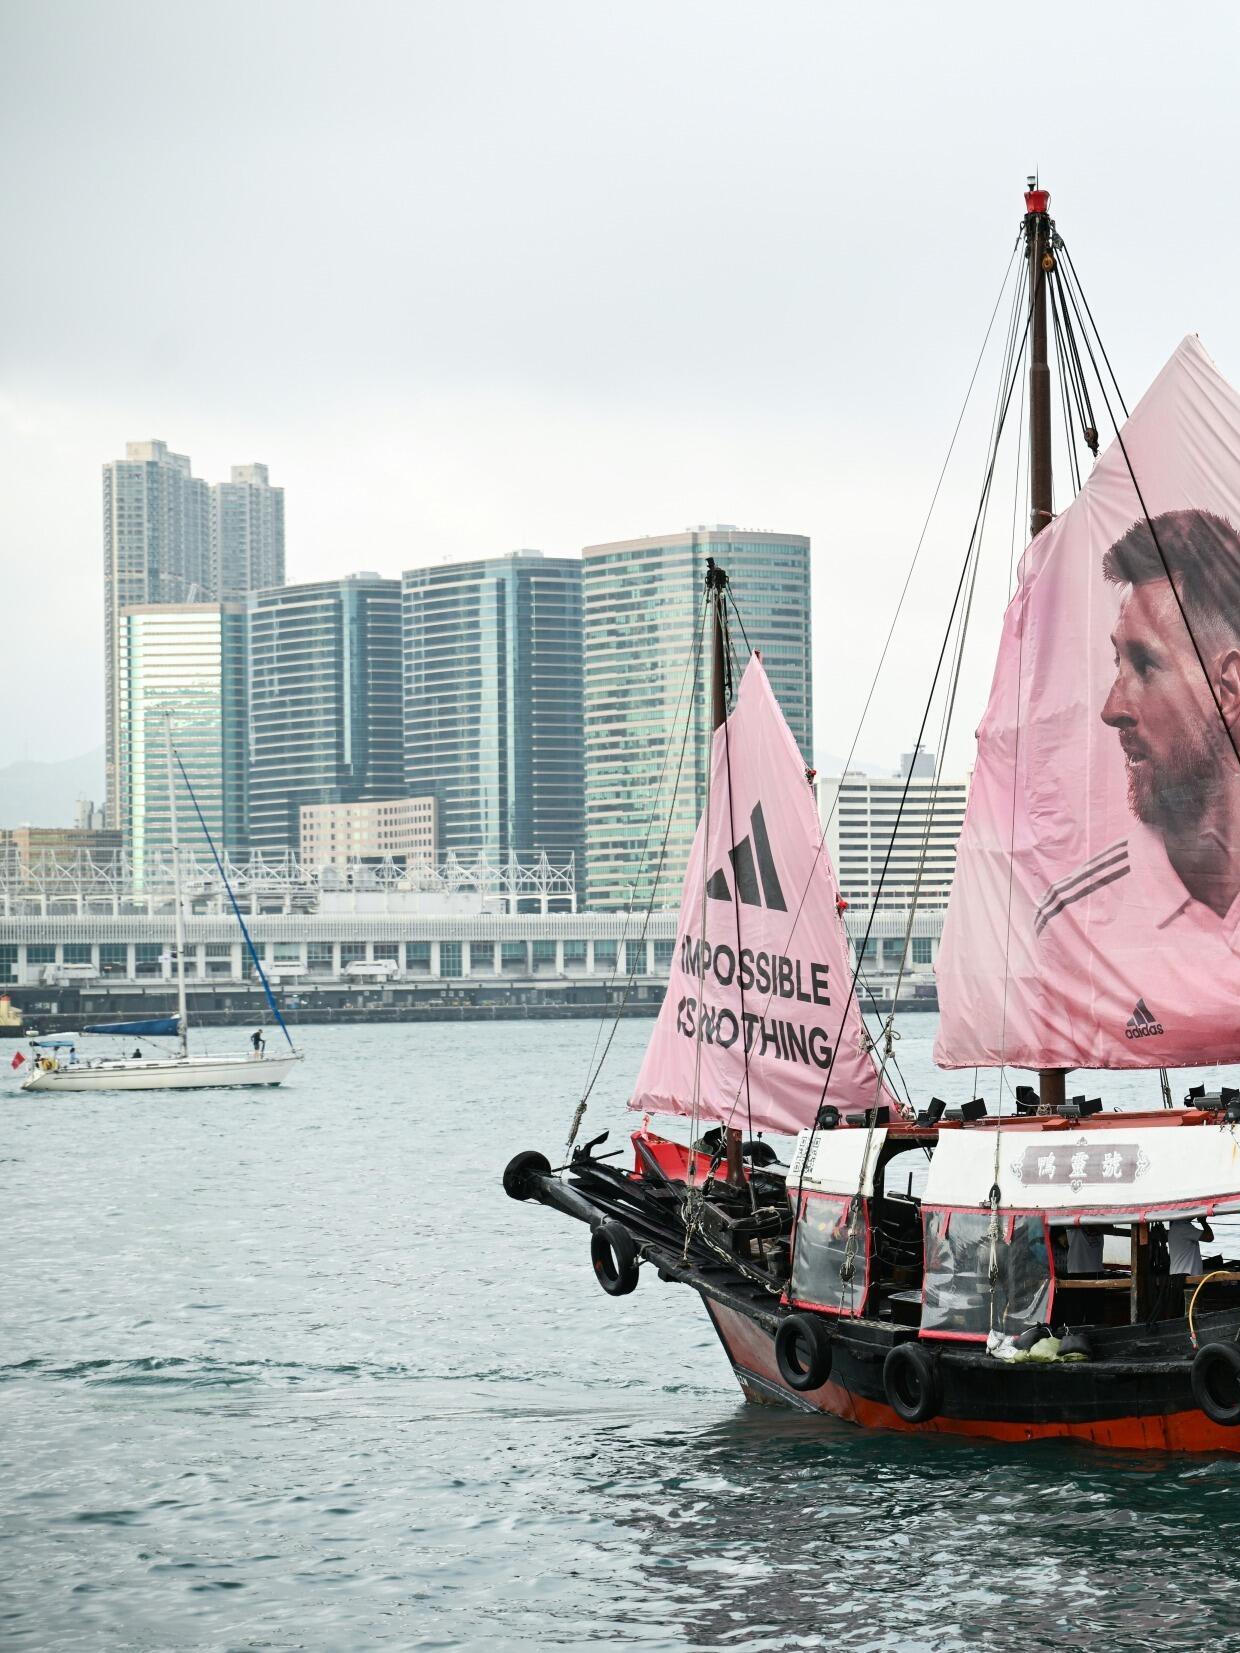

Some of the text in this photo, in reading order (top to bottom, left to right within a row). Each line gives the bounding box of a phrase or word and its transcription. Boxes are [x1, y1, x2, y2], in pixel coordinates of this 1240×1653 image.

[681, 934, 831, 1006] IMPOSSIBLE
[677, 996, 832, 1069] IS NOTHING
[1125, 1024, 1164, 1039] adidas
